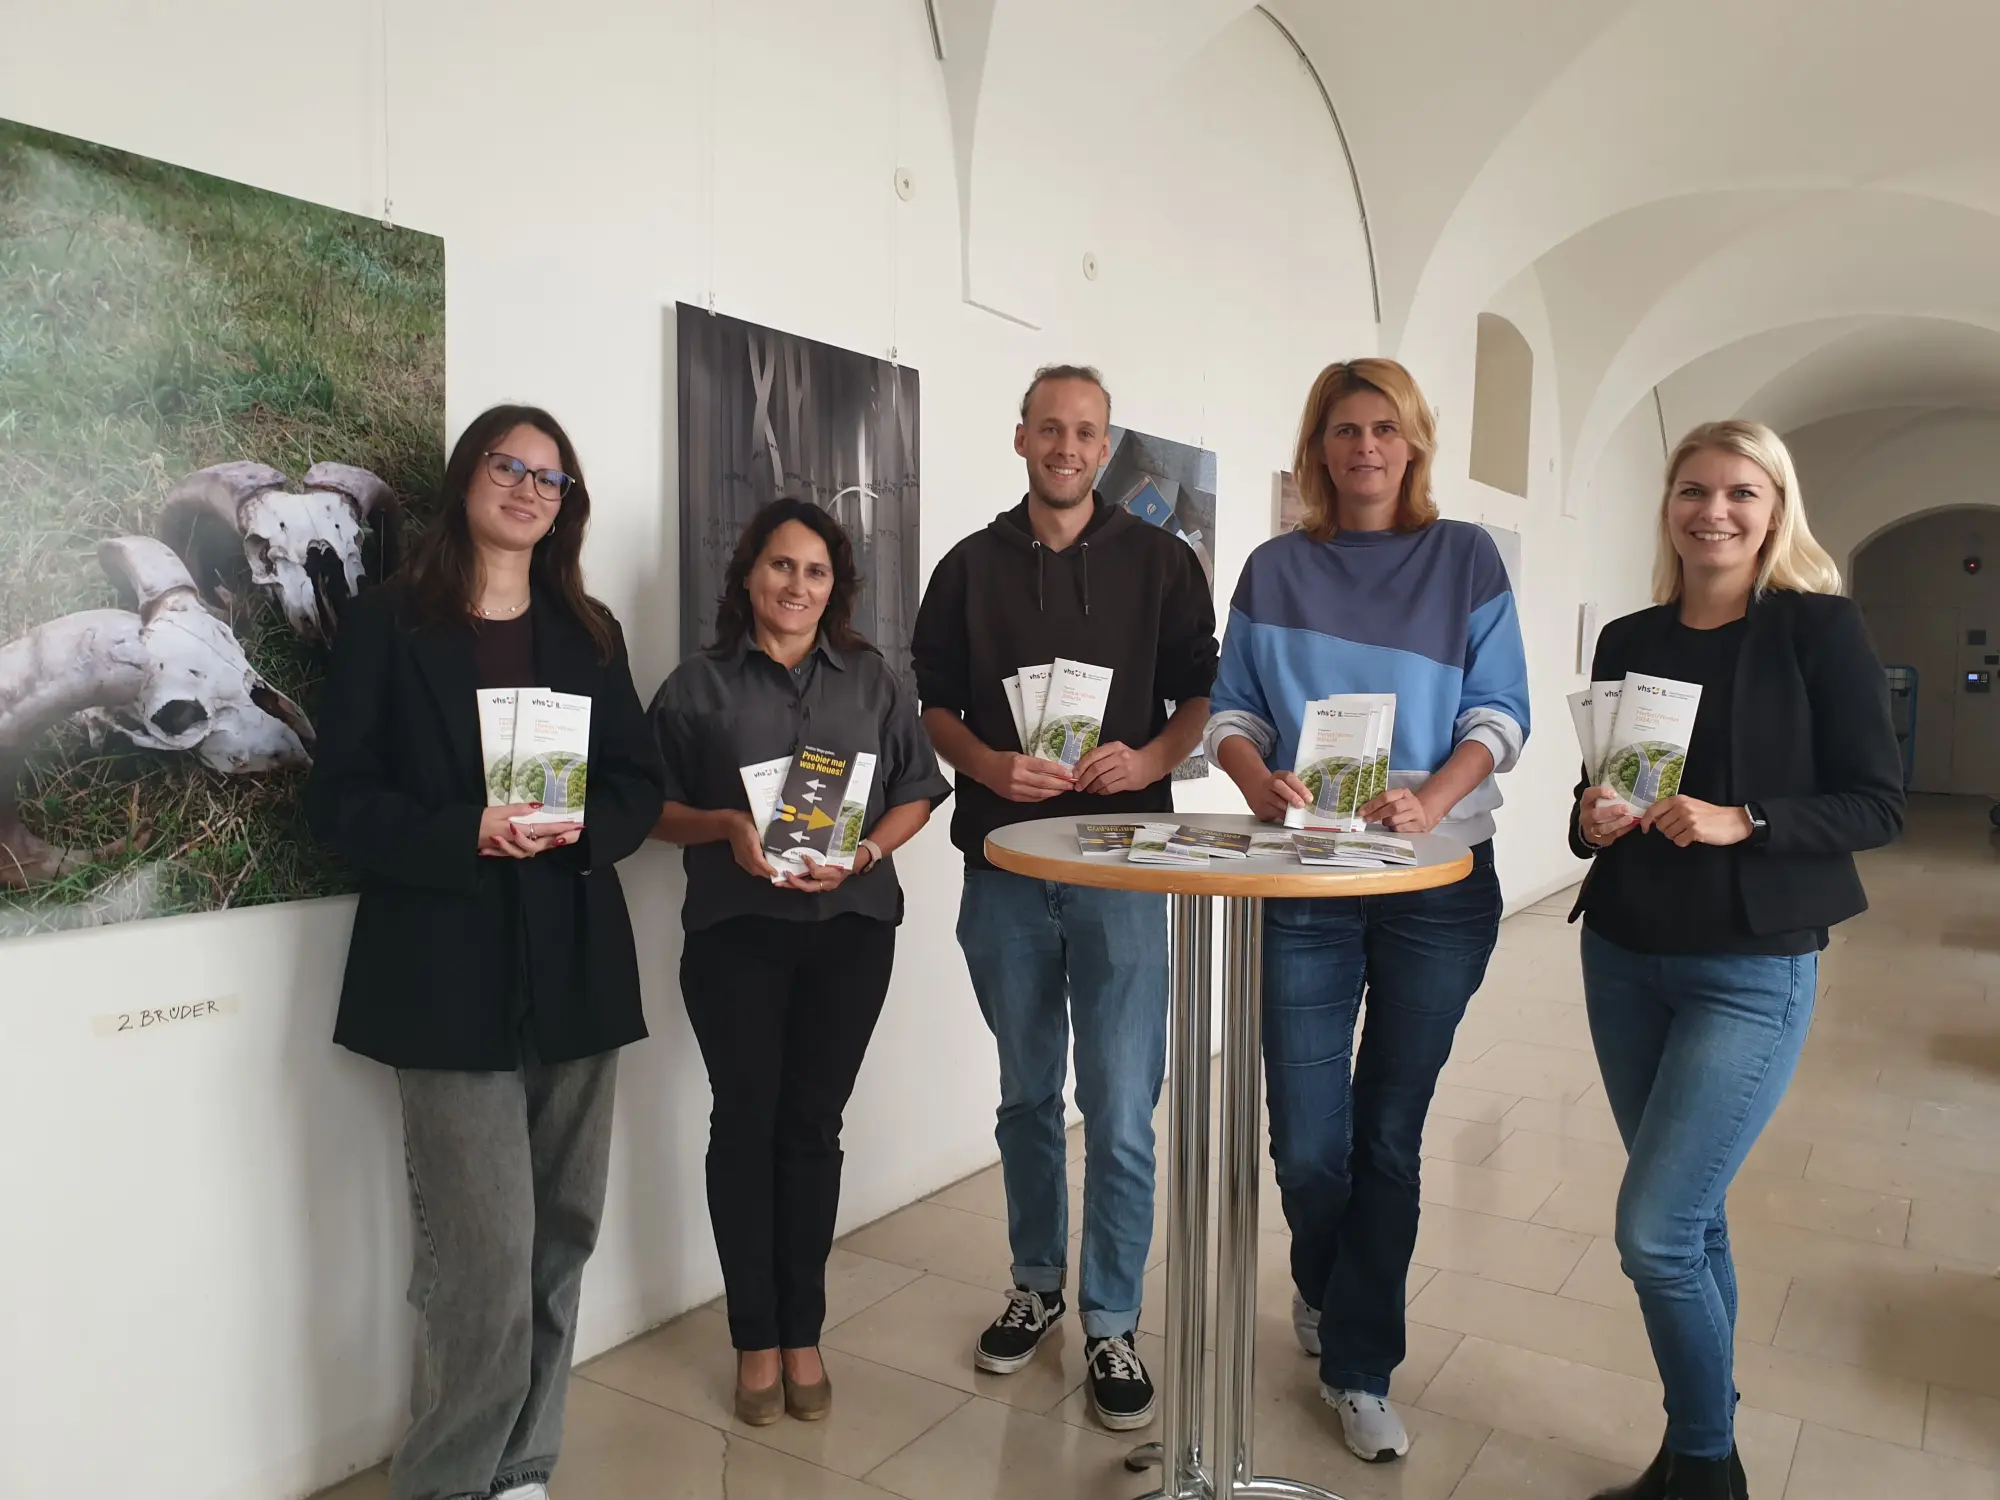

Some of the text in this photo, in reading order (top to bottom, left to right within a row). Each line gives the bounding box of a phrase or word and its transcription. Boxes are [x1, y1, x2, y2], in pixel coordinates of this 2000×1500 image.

[1604, 689, 1619, 697] vhs
[1637, 685, 1651, 693] vhs
[492, 697, 506, 705] vhs
[532, 699, 546, 707] vhs
[1317, 709, 1329, 717] vhs
[802, 750, 831, 764] Probier
[831, 758, 847, 769] mal
[799, 760, 816, 770] was
[816, 763, 844, 777] Neues!
[117, 1014, 133, 1032] 2
